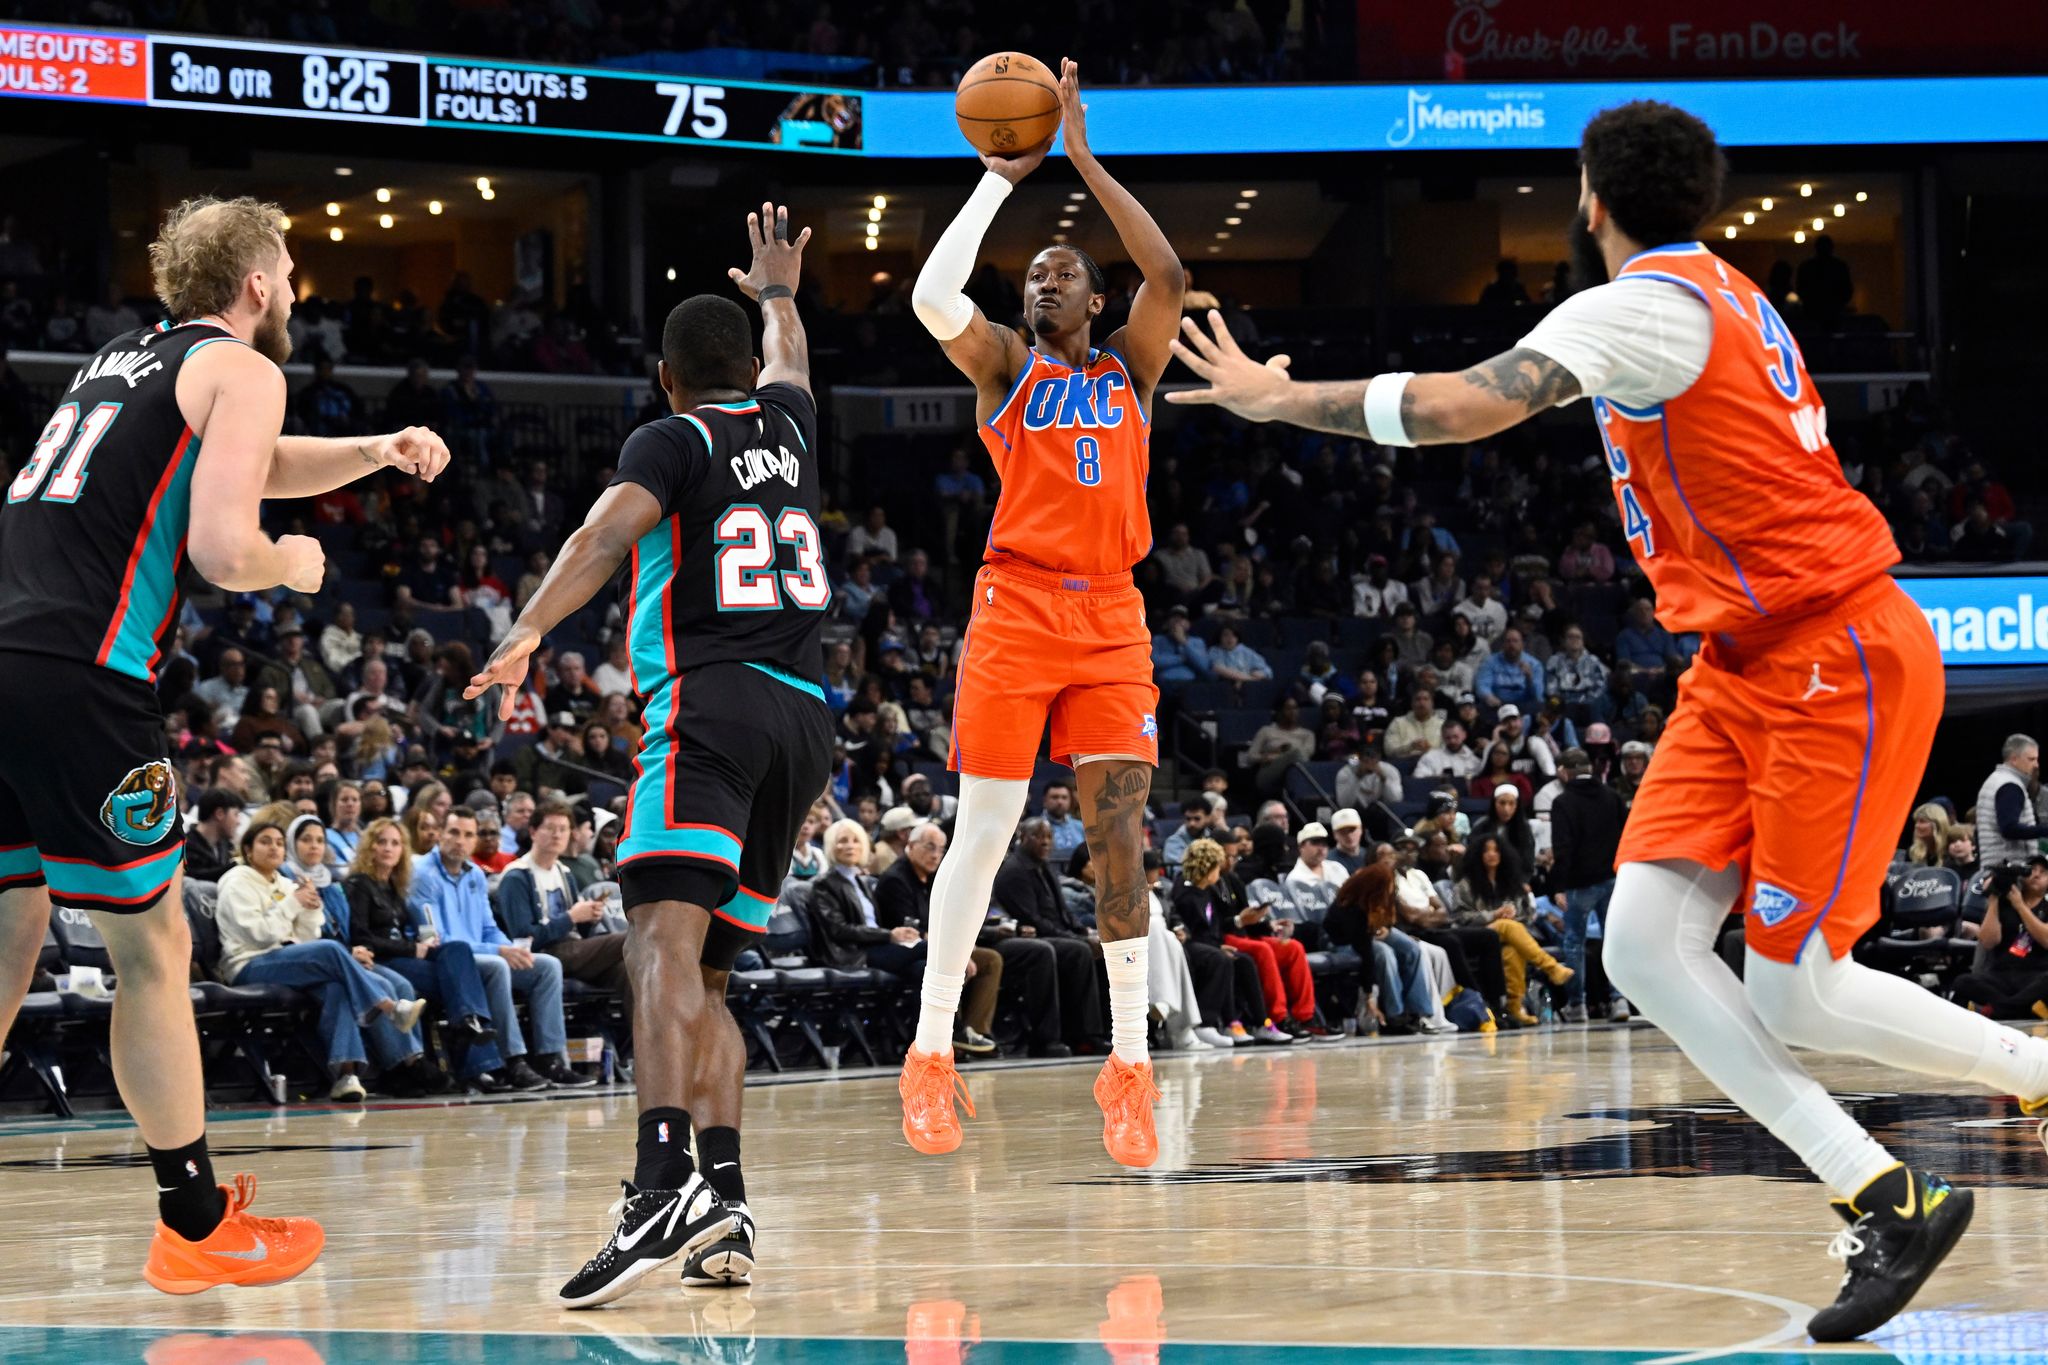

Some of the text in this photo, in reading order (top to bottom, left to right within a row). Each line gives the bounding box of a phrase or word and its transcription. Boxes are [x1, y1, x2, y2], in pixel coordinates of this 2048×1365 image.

[120, 42, 136, 67] 5
[1447, 4, 1861, 66] Chick-fil-A FanDeck
[71, 68, 89, 94] 2
[171, 52, 272, 99] 3RD QTR
[301, 55, 390, 114] 8:25
[435, 66, 587, 100] TIMEOUTS: 5
[655, 82, 728, 139] 75
[1418, 103, 1545, 135] Memphis
[908, 402, 942, 422] 111
[1023, 371, 1125, 431] OKC
[7, 401, 123, 504] 31
[1075, 436, 1101, 487] 8
[1620, 483, 1655, 558] 4
[714, 503, 832, 612] 23
